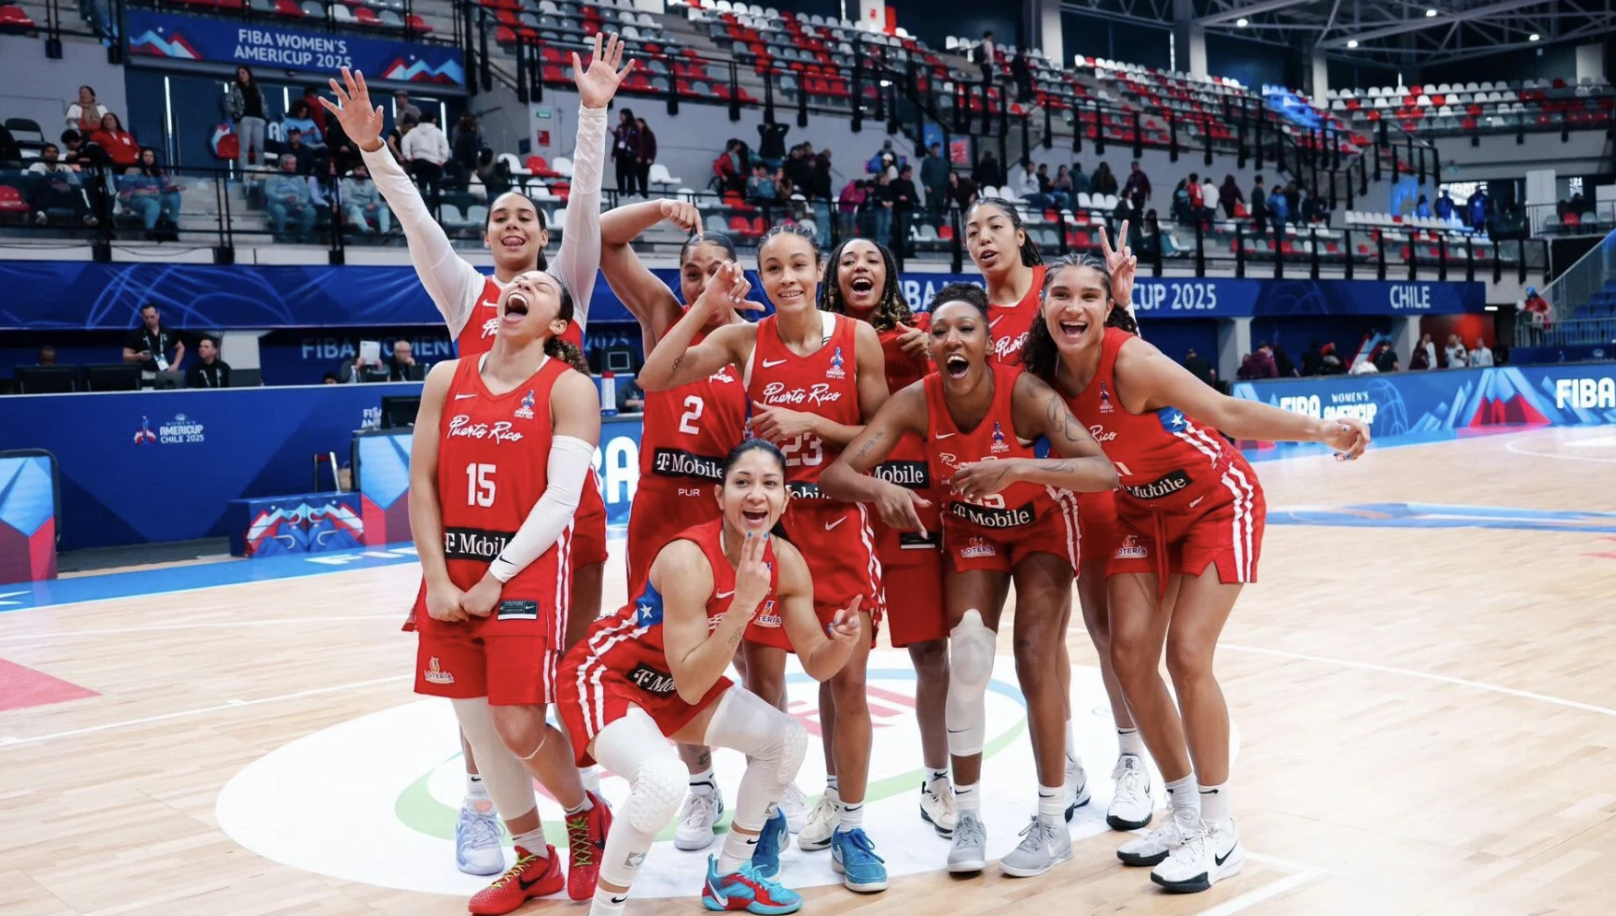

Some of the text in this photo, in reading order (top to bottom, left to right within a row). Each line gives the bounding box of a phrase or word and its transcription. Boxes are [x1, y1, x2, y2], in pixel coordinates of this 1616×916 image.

[238, 29, 347, 54] FIBA WOMEN'S
[234, 45, 352, 69] AMERICUP 2025
[1132, 283, 1216, 310] CUP 2025
[1390, 285, 1431, 309] CHILE
[302, 338, 356, 359] FIBA
[763, 382, 841, 407] Puerto Rico
[1331, 391, 1369, 403] WOMEN'S
[1556, 377, 1616, 409] FIBA
[679, 395, 704, 435] 2
[159, 425, 203, 436] AMERICUP
[160, 434, 204, 443] CHILE 2025
[447, 415, 523, 445] Puerto Rico
[1090, 425, 1117, 446] Rico
[781, 433, 823, 466] 23
[466, 463, 496, 507] 15
[678, 488, 700, 497] PUR
[969, 509, 1030, 527] Mobile
[459, 533, 507, 557] Mobil
